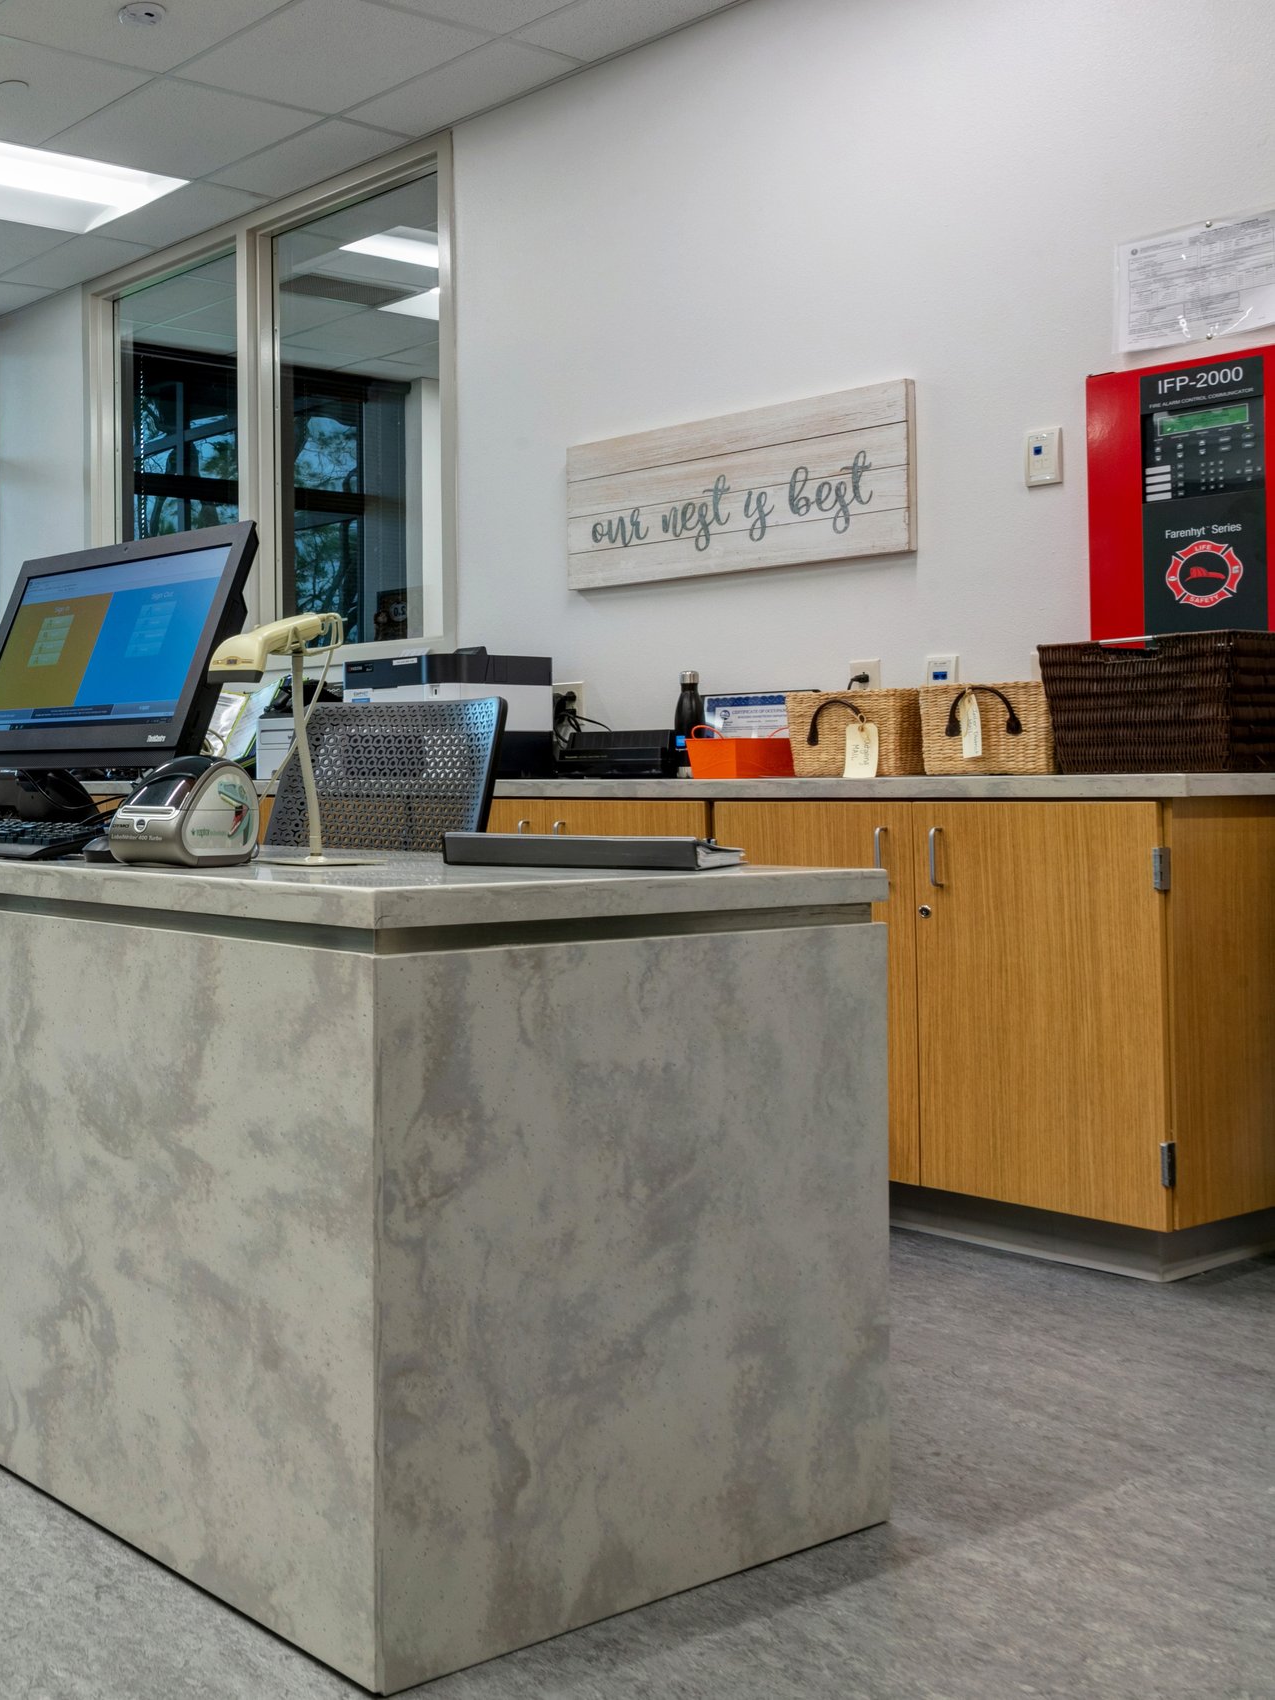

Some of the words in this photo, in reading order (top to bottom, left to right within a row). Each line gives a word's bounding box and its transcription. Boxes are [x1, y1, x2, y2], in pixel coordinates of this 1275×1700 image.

[1157, 366, 1243, 395] IFP-2000
[1181, 395, 1207, 404] CONTROL
[1208, 387, 1254, 400] COMMUNICATOR
[591, 508, 649, 547] our
[661, 474, 731, 551] nest
[743, 489, 774, 542] is
[788, 450, 873, 534] best
[1165, 526, 1206, 539] Farenhyt
[1211, 523, 1242, 534] Series
[1194, 544, 1212, 552] LIFE
[1189, 594, 1219, 604] SAFETY
